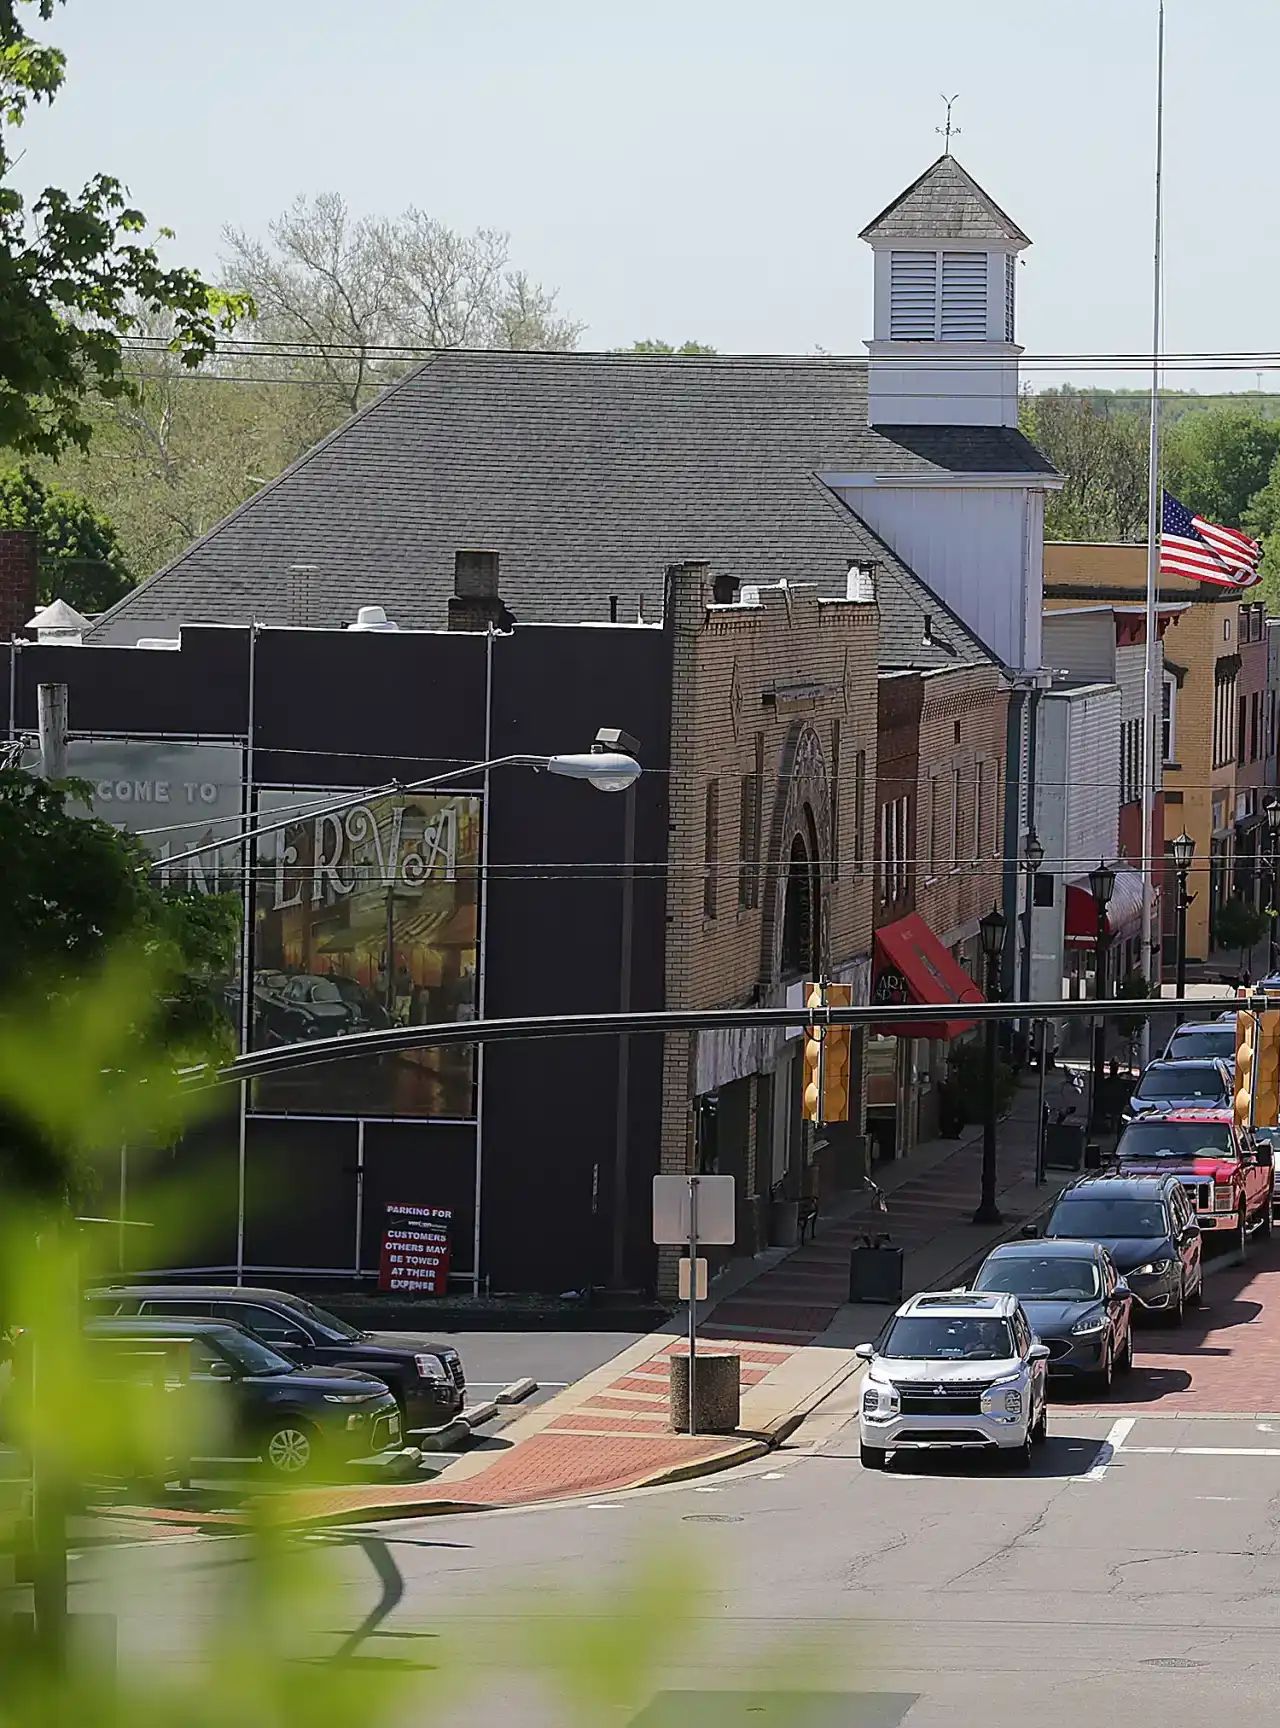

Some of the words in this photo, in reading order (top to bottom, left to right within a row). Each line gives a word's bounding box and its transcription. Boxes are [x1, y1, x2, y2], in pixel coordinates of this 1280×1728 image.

[96, 780, 170, 803] COME
[184, 782, 218, 804] TO
[387, 1206, 430, 1216] PARKING
[432, 1210, 452, 1218] FOR
[387, 1230, 447, 1242] CUSTOMERS
[385, 1242, 424, 1253] OTHERS
[426, 1245, 447, 1254] MAY
[390, 1254, 404, 1263] BE
[405, 1255, 440, 1266] TOWED
[406, 1268, 435, 1278] THEIR
[391, 1279, 434, 1291] EXPENSE
